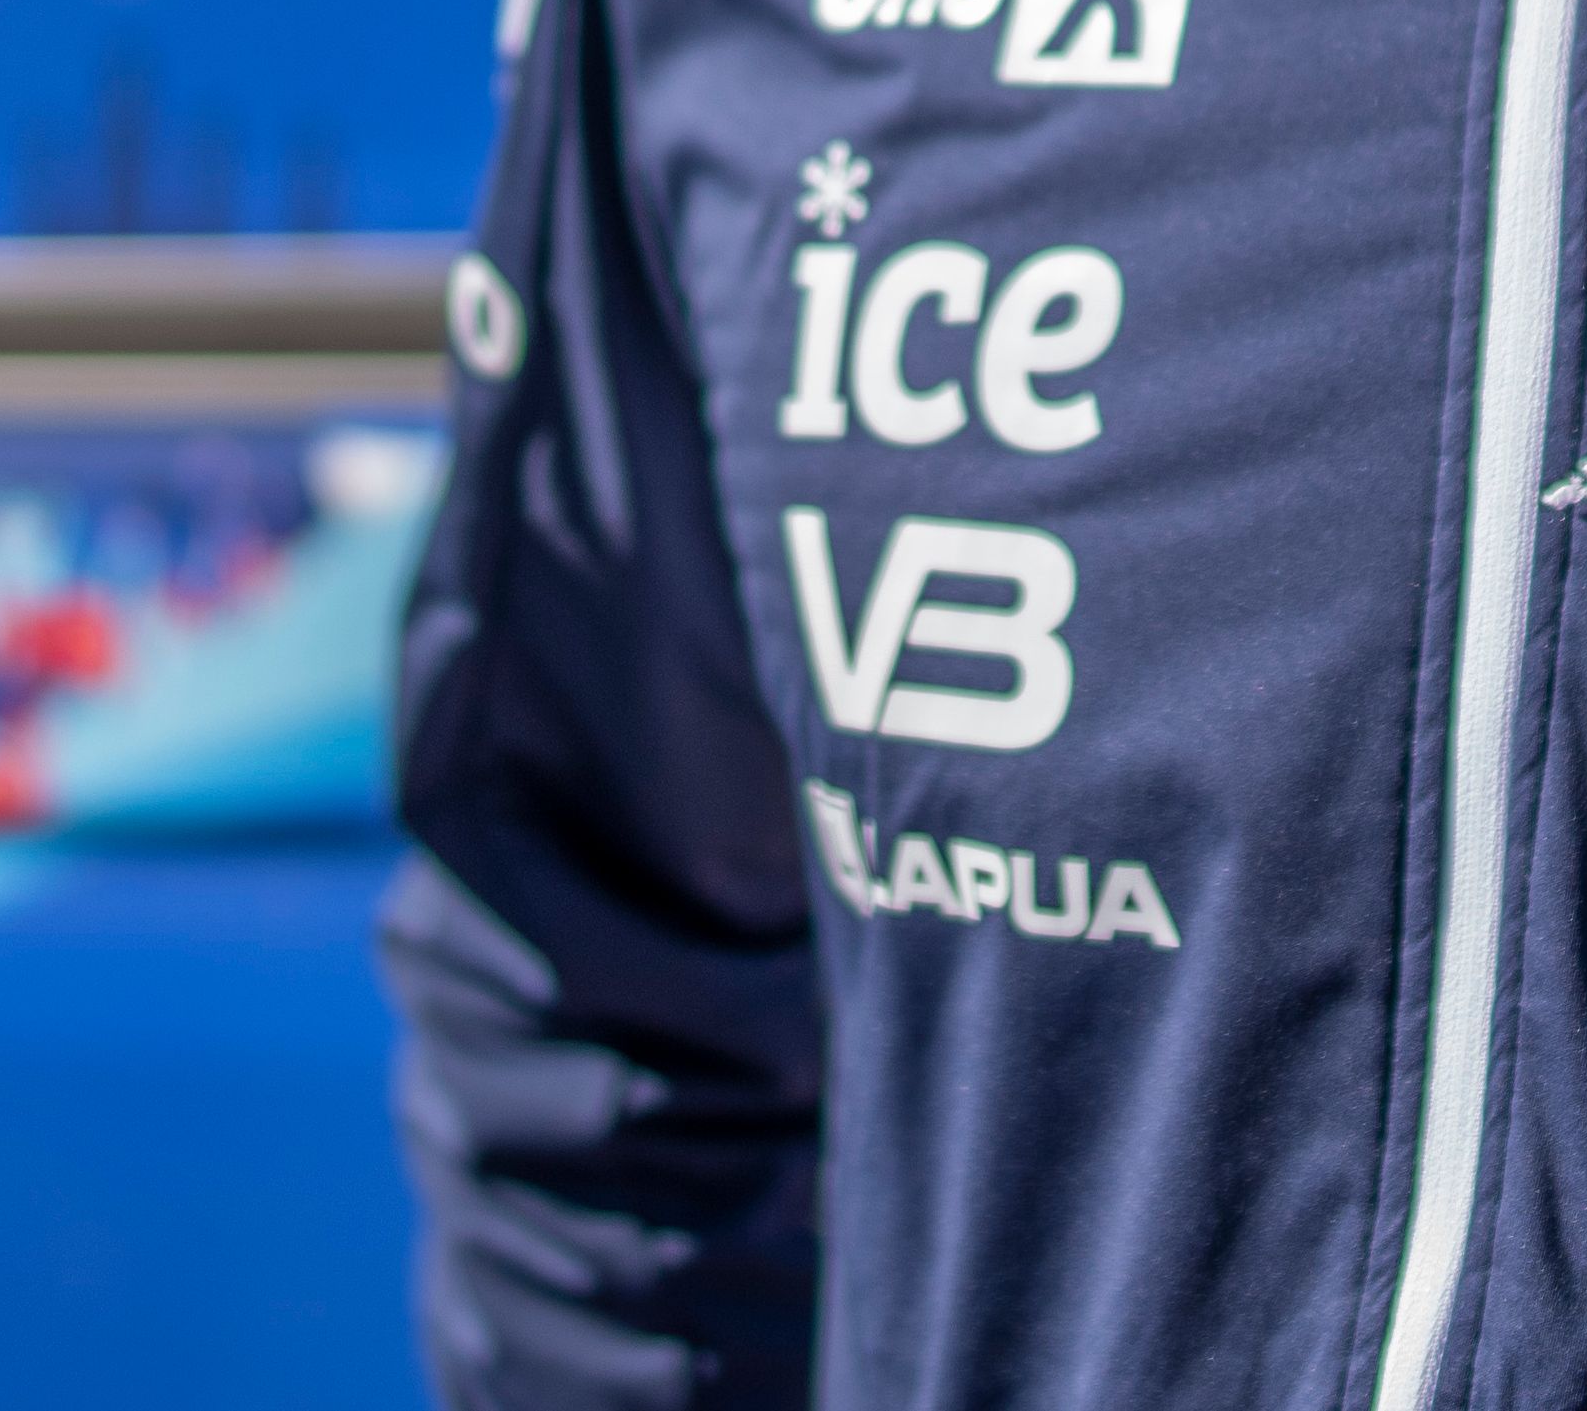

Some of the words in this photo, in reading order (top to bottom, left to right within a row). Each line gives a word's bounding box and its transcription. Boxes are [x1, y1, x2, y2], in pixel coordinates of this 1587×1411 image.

[779, 139, 1125, 455] ice
[783, 505, 1078, 751] VB
[805, 778, 1182, 948] LAPUA
